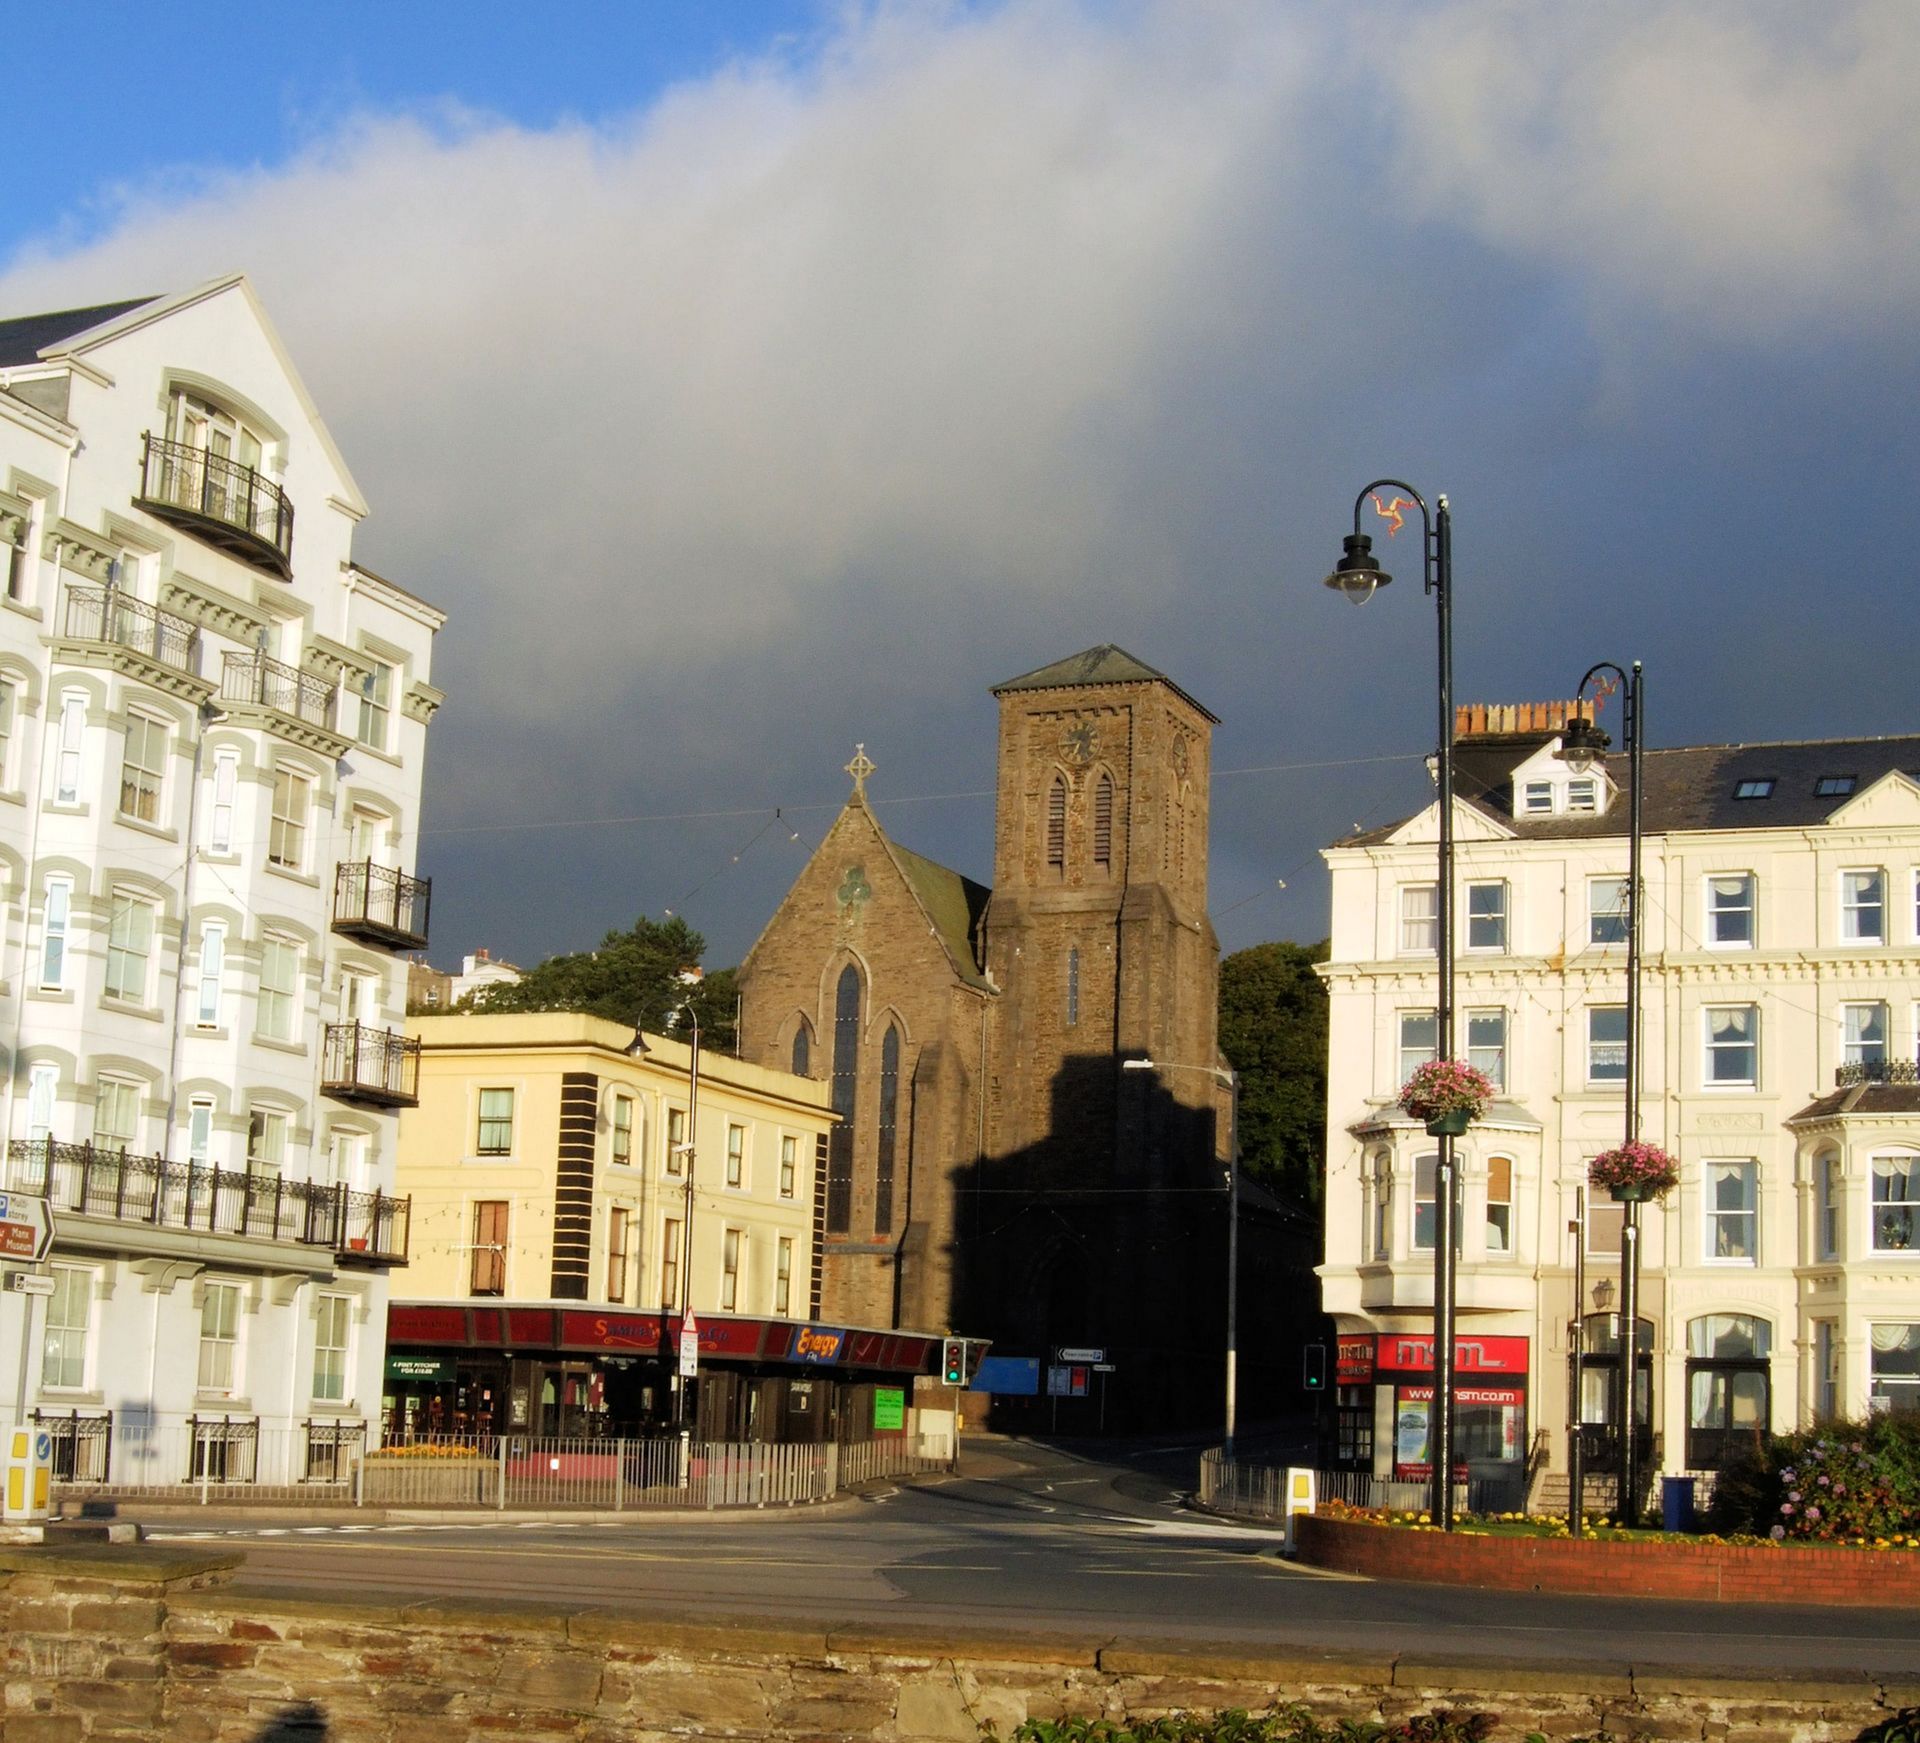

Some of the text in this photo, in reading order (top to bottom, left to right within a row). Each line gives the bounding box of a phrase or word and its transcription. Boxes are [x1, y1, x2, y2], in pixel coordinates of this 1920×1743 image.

[12, 1227, 29, 1238] Manx
[6, 1239, 32, 1251] Museum
[797, 1327, 840, 1358] Energy
[1409, 1389, 1515, 1402] wwsm.co.im
